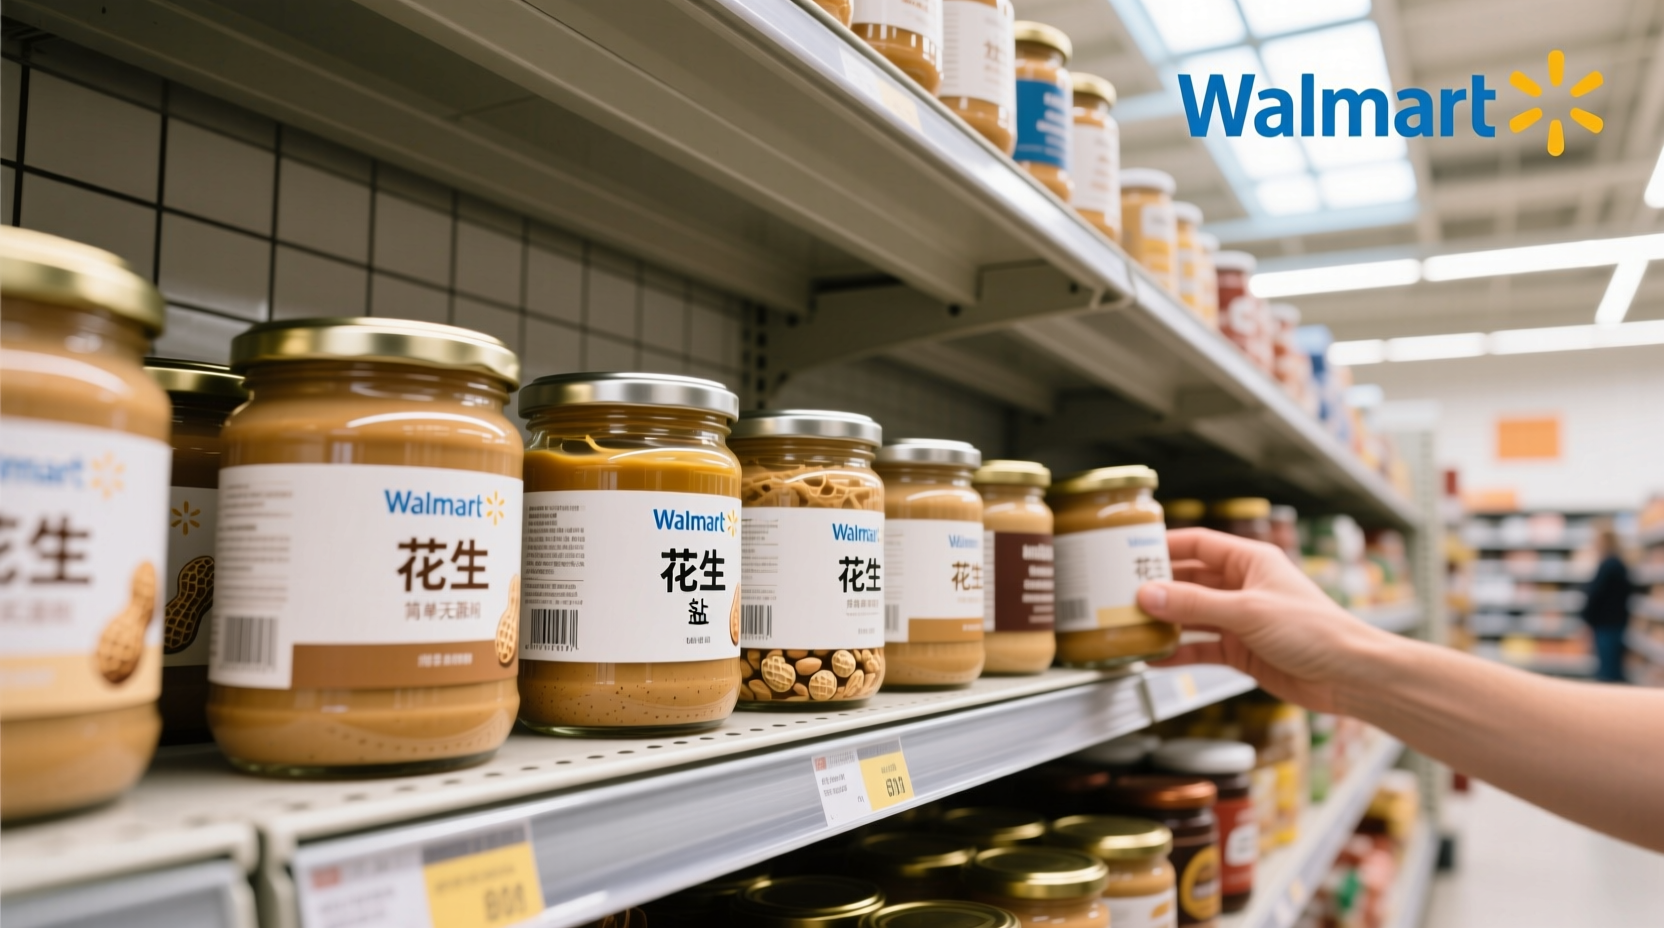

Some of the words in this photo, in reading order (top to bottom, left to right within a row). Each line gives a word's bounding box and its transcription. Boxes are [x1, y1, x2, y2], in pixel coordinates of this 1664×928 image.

[384, 489, 483, 518] Walmart
[653, 509, 725, 532] Walmart
[397, 537, 489, 592] 花生
[660, 548, 726, 593] 花生
[838, 556, 881, 593] 花生
[952, 561, 983, 591] 花生
